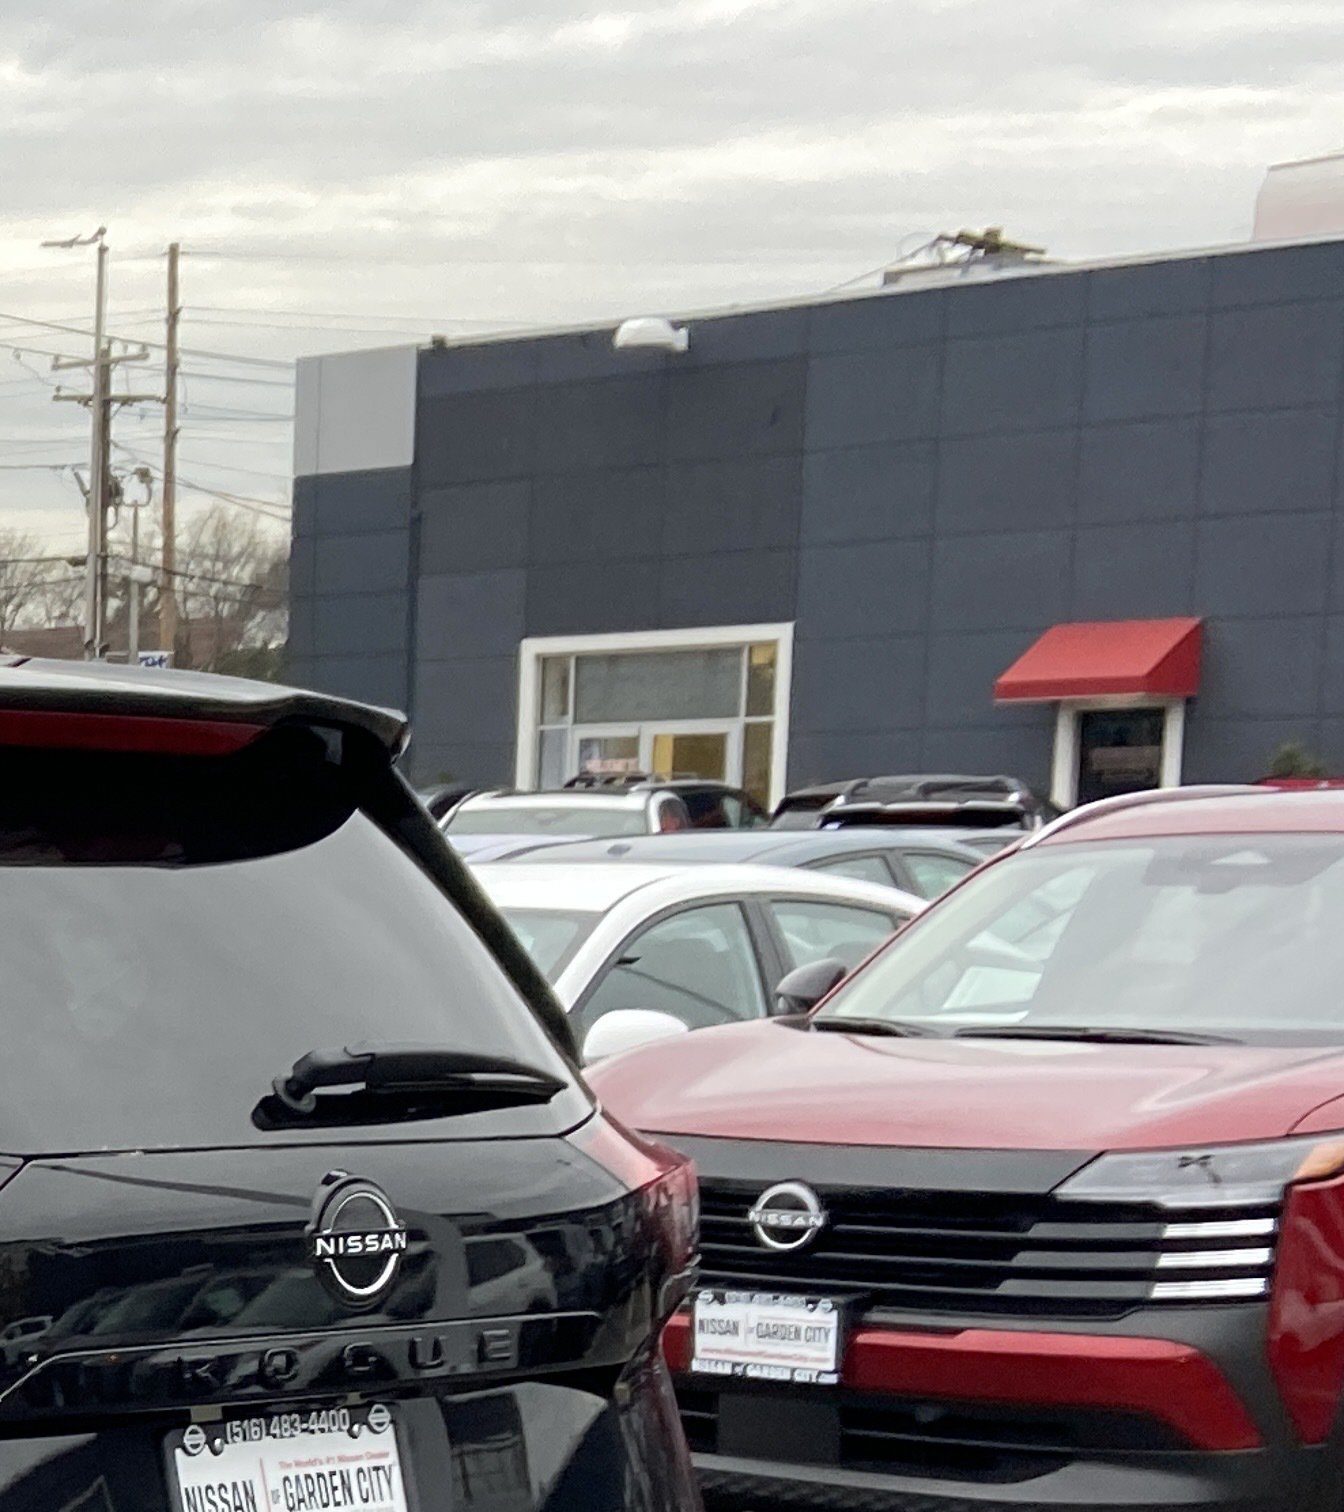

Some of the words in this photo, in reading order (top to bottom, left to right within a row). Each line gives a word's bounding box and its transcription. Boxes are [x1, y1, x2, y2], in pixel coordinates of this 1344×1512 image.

[750, 1211, 824, 1228] NISSAN
[315, 1231, 407, 1256] NISSAN
[698, 1318, 740, 1337] NISSAN
[756, 1322, 802, 1342] GARDEN
[804, 1326, 831, 1344] CITY
[226, 1417, 267, 1444] (516)
[269, 1408, 351, 1438] 483-4400
[282, 1468, 354, 1512] GARDEN
[356, 1463, 394, 1504] CITY
